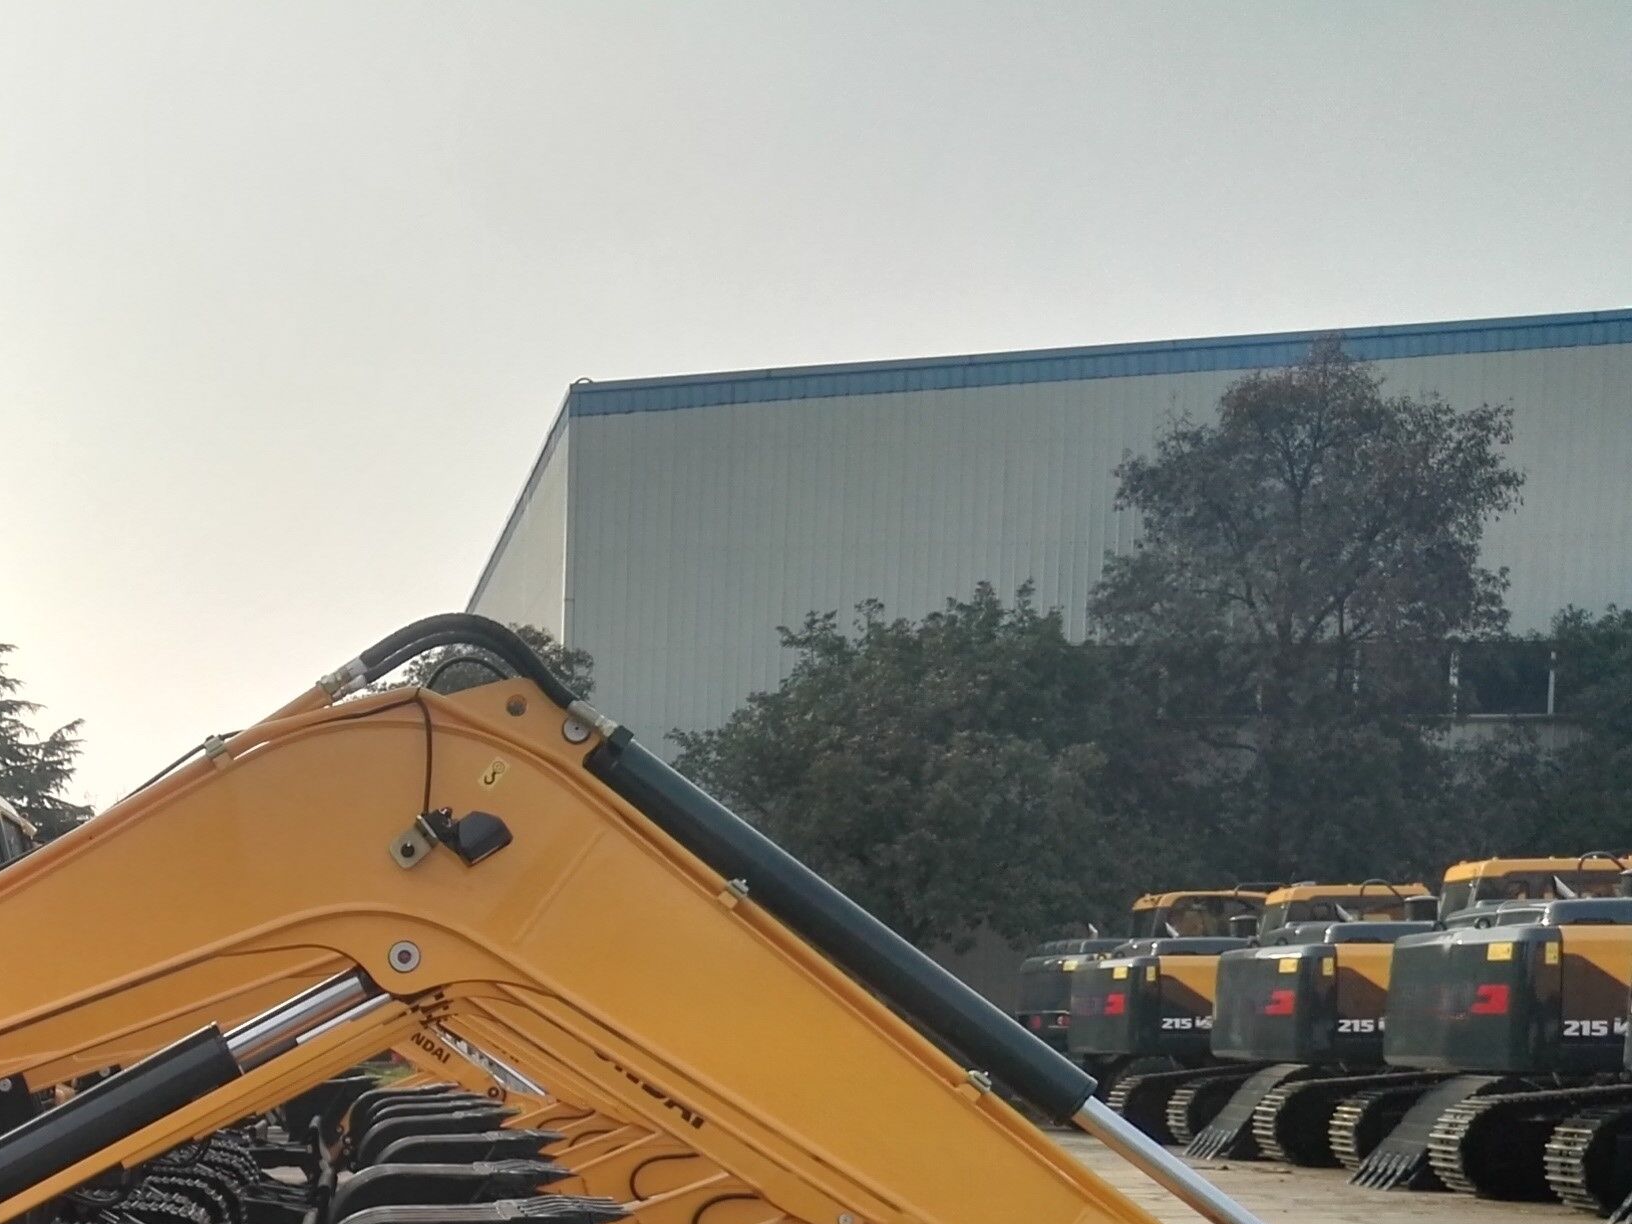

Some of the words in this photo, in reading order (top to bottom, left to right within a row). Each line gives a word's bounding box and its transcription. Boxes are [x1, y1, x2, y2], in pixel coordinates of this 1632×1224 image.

[1161, 1017, 1192, 1029] 215
[1338, 1019, 1374, 1033] 215
[1563, 1020, 1608, 1037] 215
